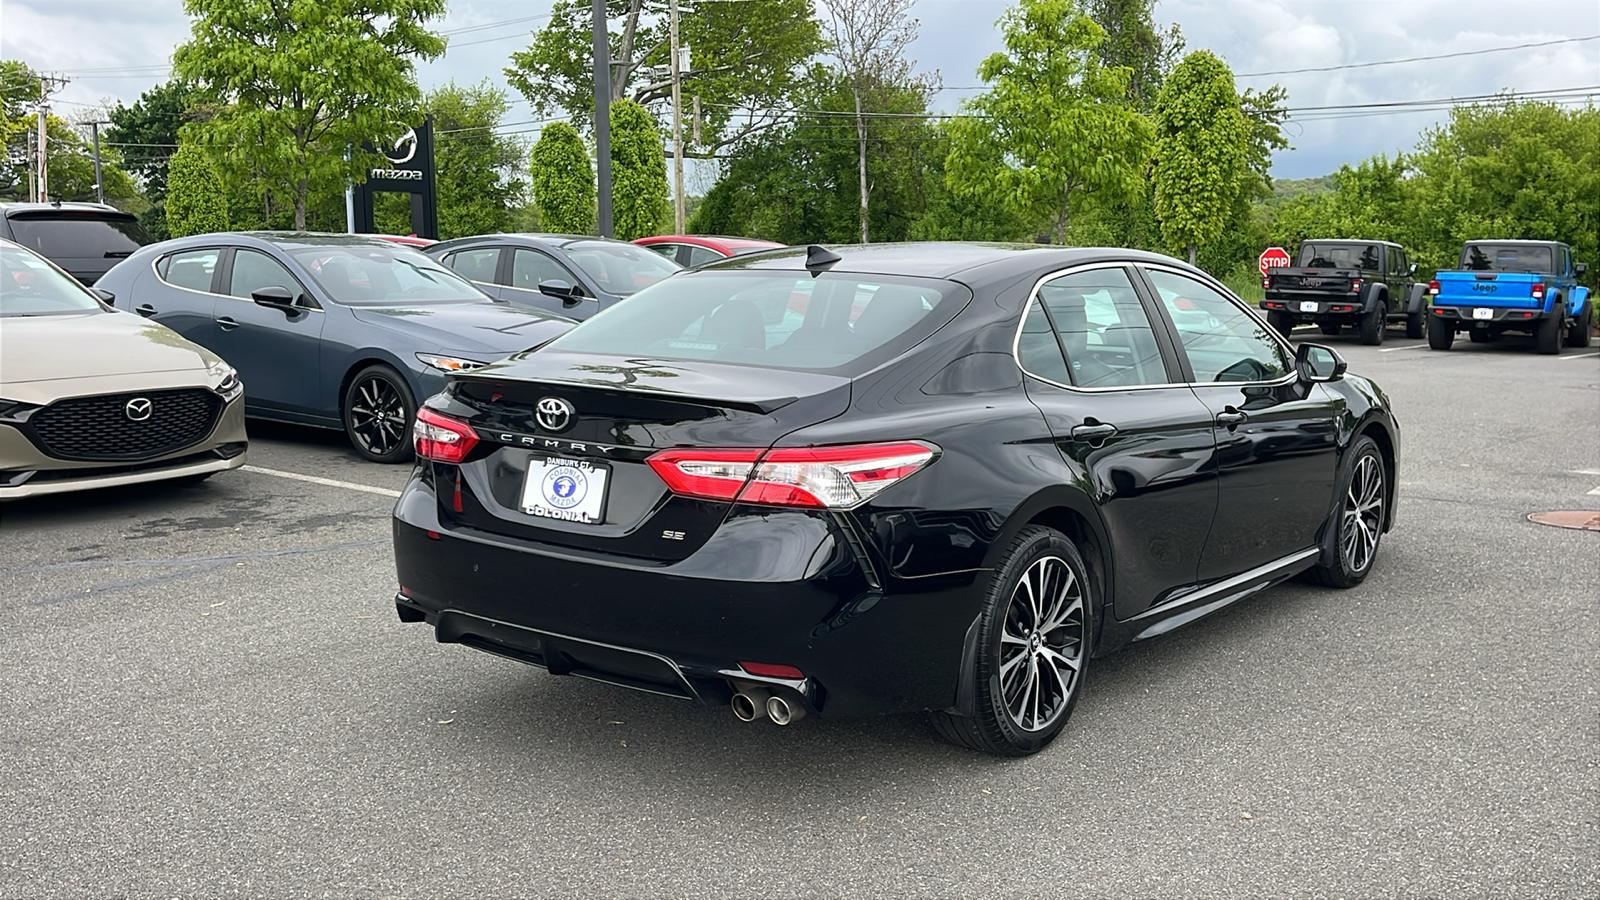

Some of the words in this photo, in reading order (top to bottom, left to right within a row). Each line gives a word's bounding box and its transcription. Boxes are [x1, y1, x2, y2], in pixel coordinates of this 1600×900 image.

[1261, 257, 1288, 269] STOP
[1299, 278, 1321, 287] Jeep
[1472, 283, 1497, 292] Jeep
[500, 433, 615, 453] CAMRY
[549, 468, 584, 486] COLONIAL
[550, 495, 577, 507] MAZDA
[525, 504, 592, 524] COLONIAL
[661, 530, 686, 540] SE
